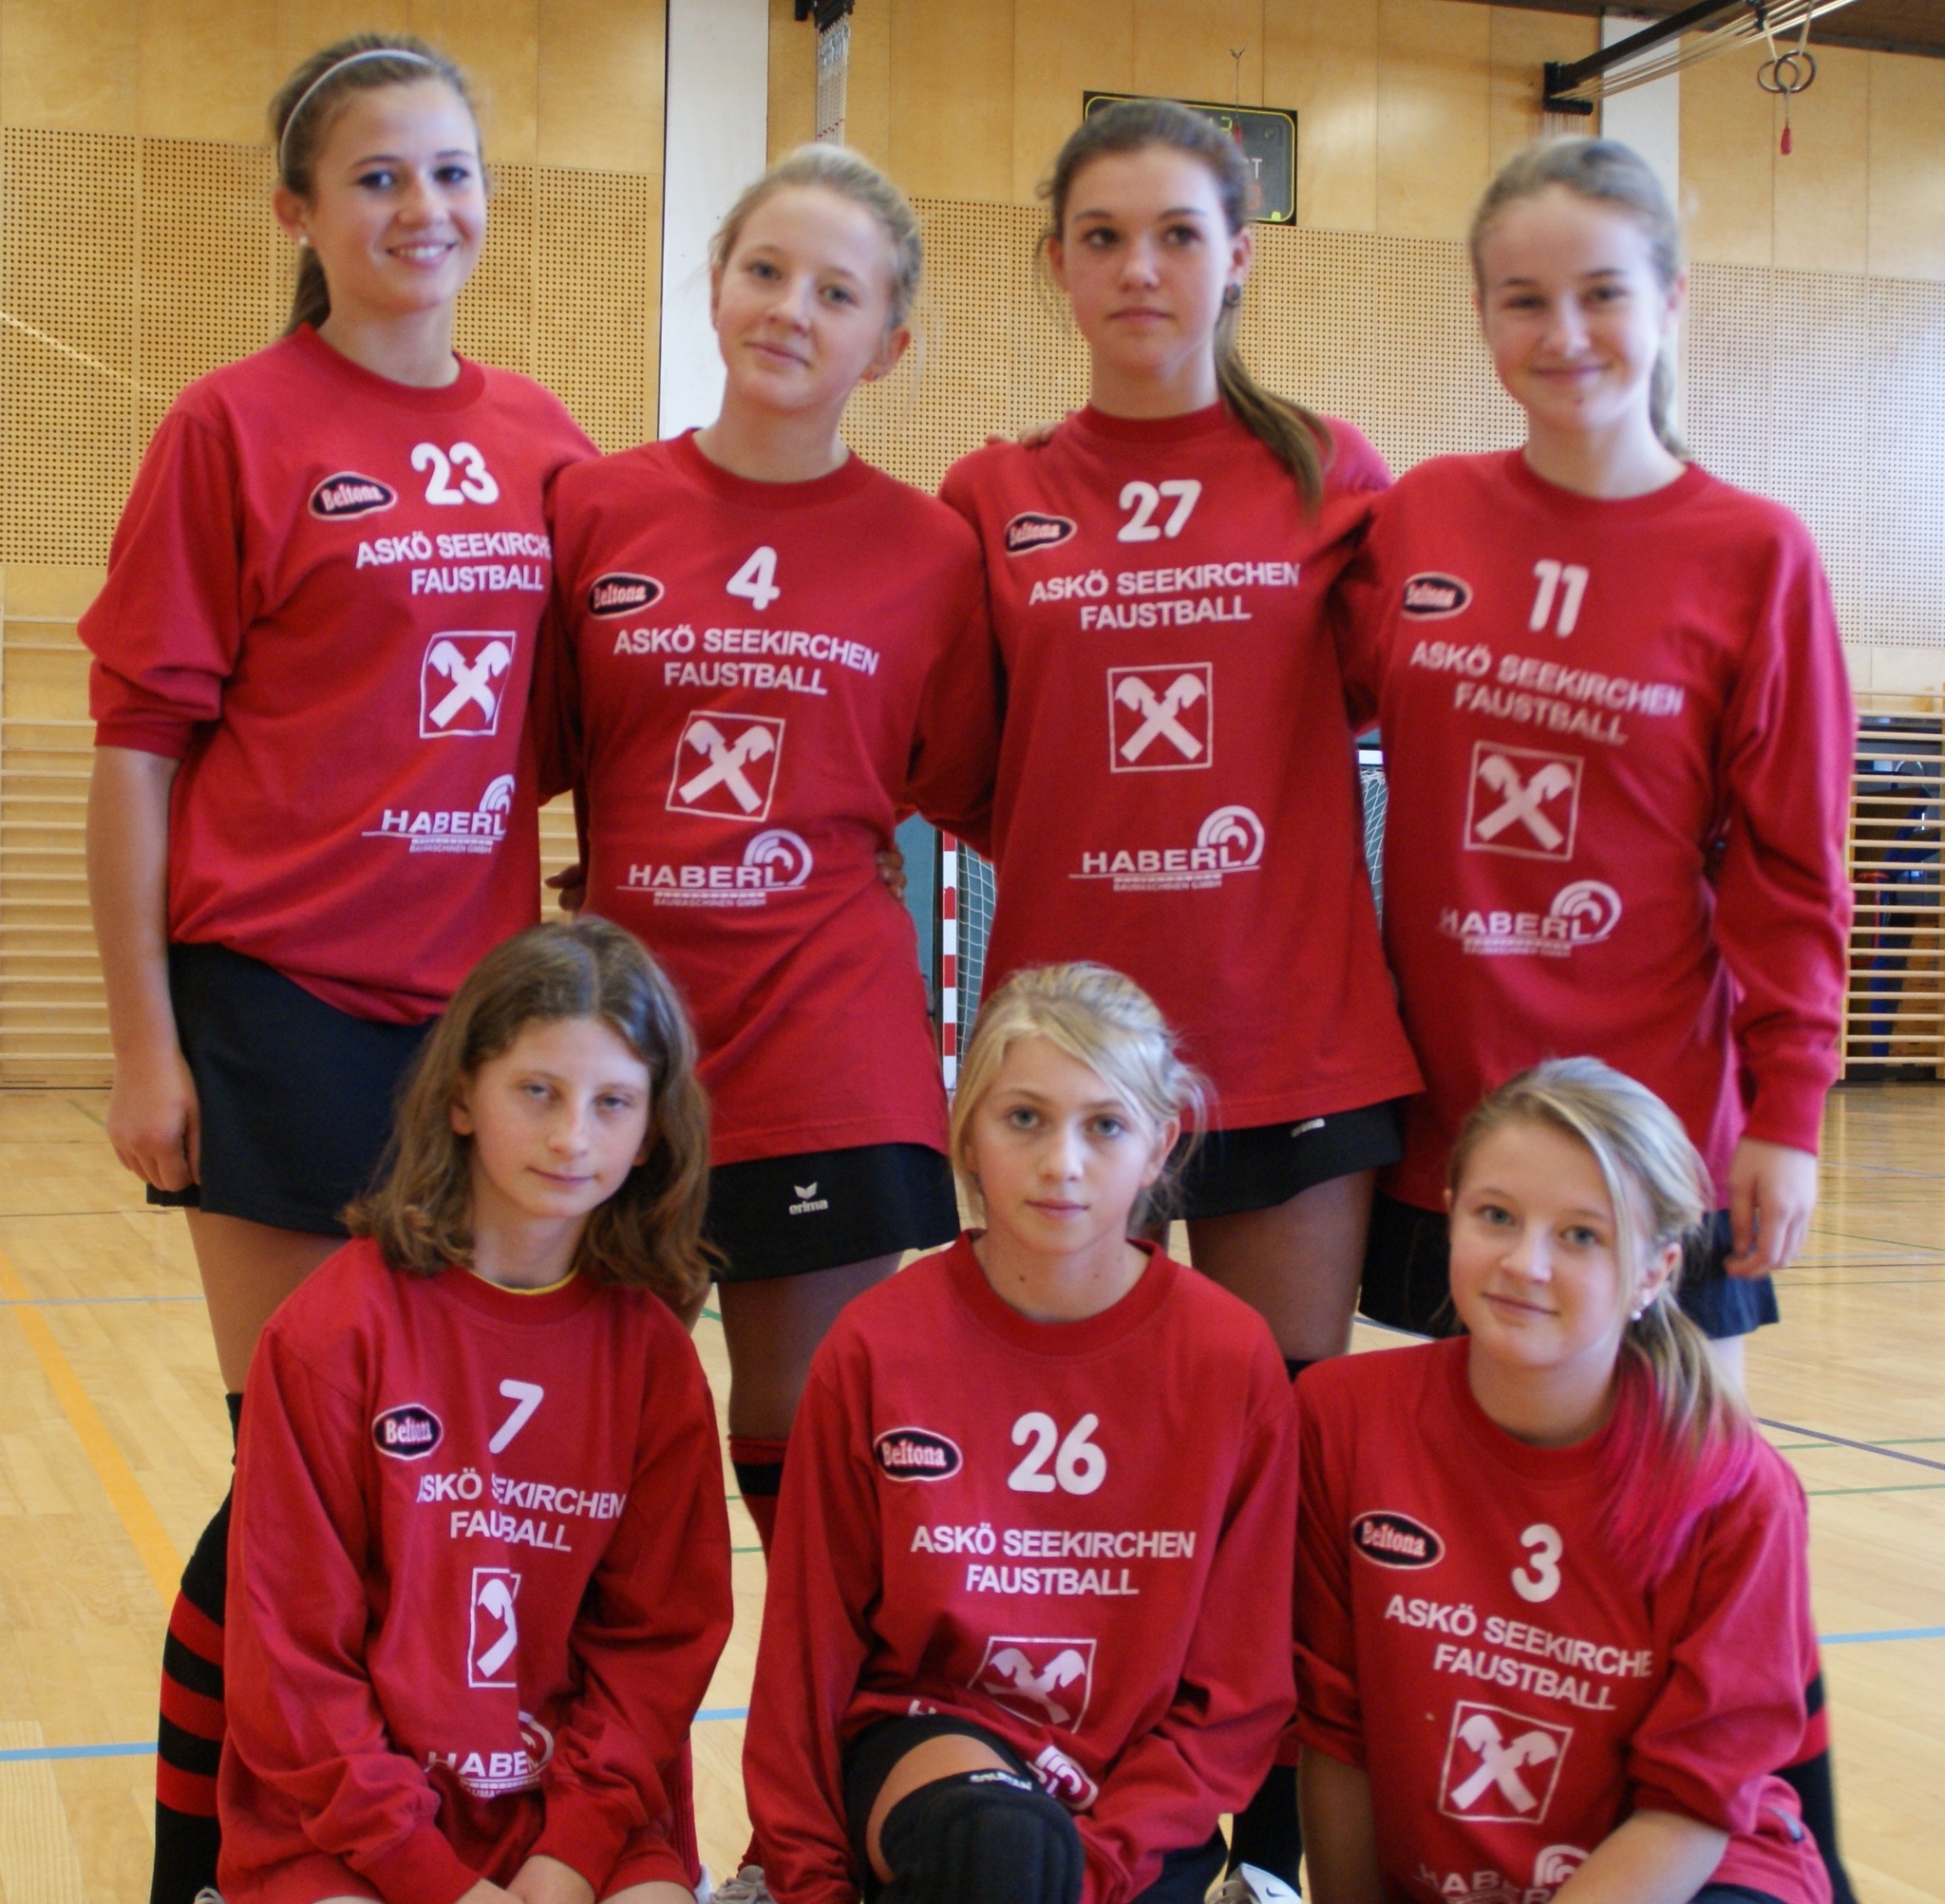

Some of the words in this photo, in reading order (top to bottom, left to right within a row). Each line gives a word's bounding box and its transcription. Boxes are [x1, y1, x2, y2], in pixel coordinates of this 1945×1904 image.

[411, 442, 499, 504] 23
[1117, 480, 1201, 542] 27
[355, 530, 433, 569] ASKÖ
[410, 564, 544, 595] FAUSTBALL
[727, 546, 781, 611] 4
[1029, 570, 1109, 605] ASKÖ
[1116, 562, 1300, 596] SEEKIRCHEN
[1527, 558, 1590, 638] 11
[1080, 595, 1252, 631] FAUSTBALL
[614, 624, 696, 655] ASKÖ
[703, 628, 880, 676] SEEKIRCHEN
[665, 662, 828, 695] FAUSTBALL
[1409, 640, 1492, 677] ASKÖ
[1497, 654, 1685, 716] SEEKIRCHEN
[1453, 680, 1628, 745] FAUSTBALL
[382, 808, 507, 835] HABERL
[628, 864, 785, 889] HABERL
[1082, 845, 1242, 874] HABERL
[489, 1379, 544, 1454] 7
[882, 1439, 947, 1467] Beltona
[1008, 1411, 1106, 1495] 26
[911, 1522, 996, 1555] ASKÖ
[1002, 1529, 1197, 1559] SEEKIRCHEN
[1362, 1521, 1426, 1557] Beltona
[965, 1564, 1140, 1596] FAUSTBALL
[1511, 1523, 1563, 1603] 3
[1385, 1594, 1478, 1636] ASKÖ
[1432, 1644, 1616, 1710] FAUSTBALL
